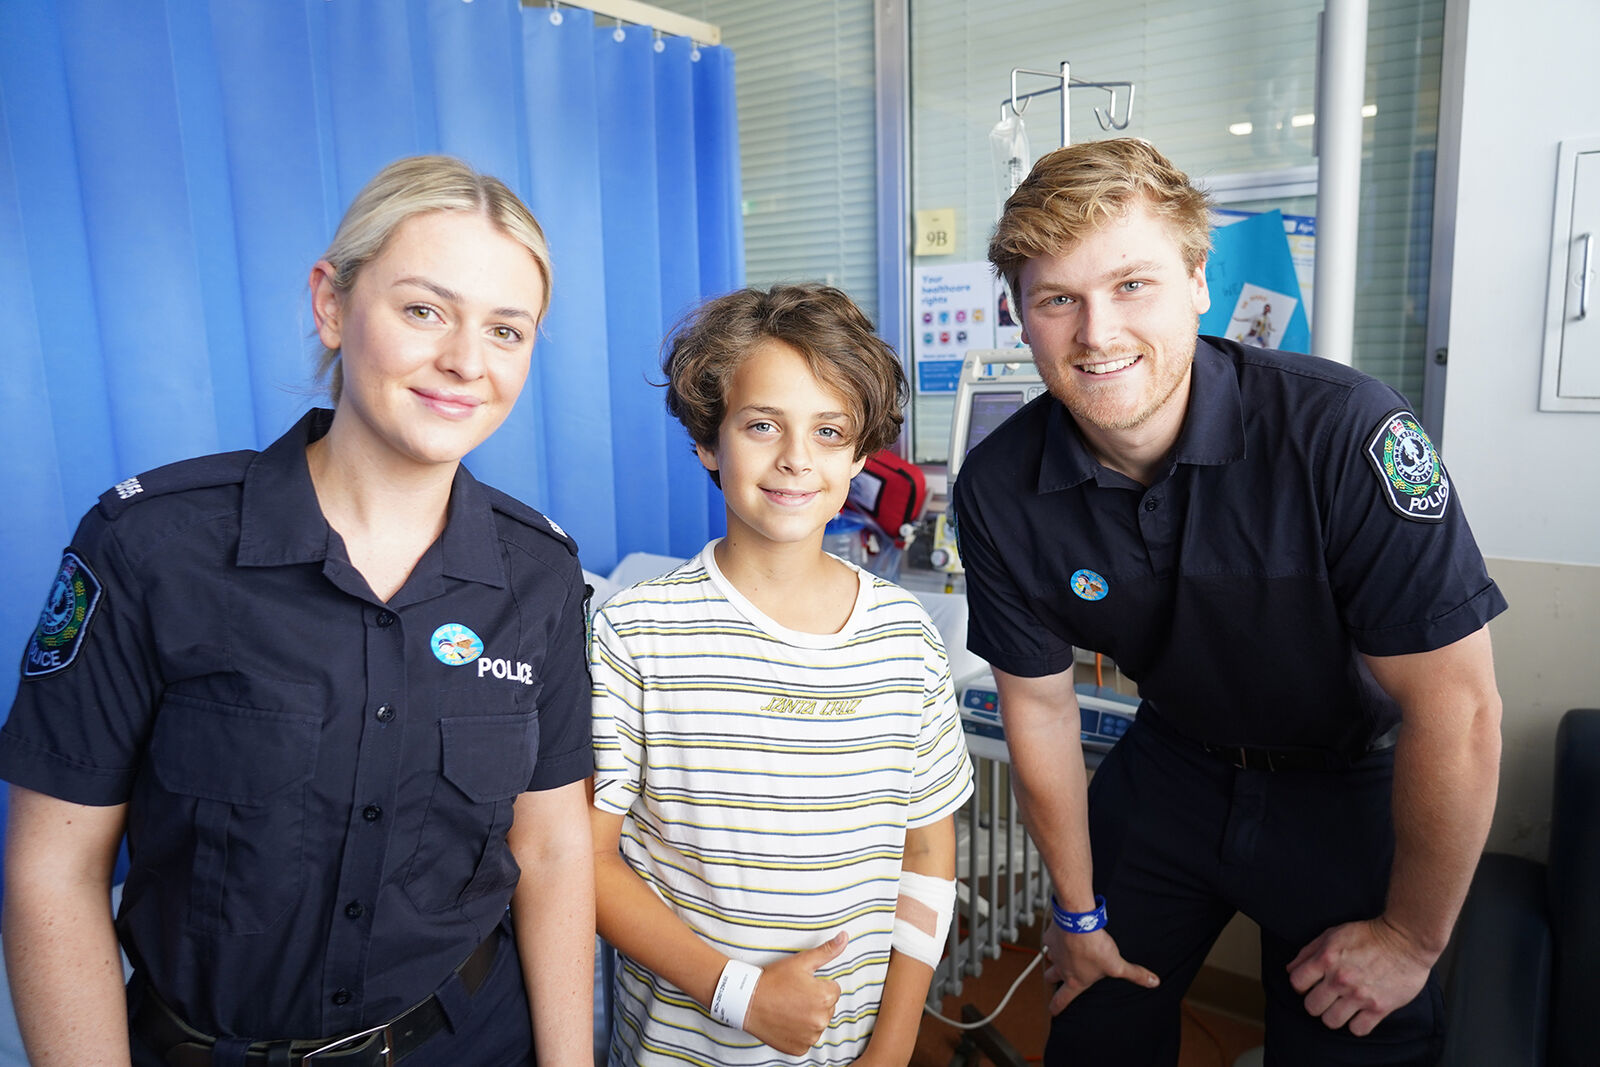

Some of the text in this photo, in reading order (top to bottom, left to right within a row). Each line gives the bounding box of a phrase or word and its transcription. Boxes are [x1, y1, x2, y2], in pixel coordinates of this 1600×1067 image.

[926, 230, 948, 247] 9B
[922, 275, 943, 283] Your
[477, 657, 534, 685] POLICE
[760, 696, 863, 716] SANTA CRUZ
